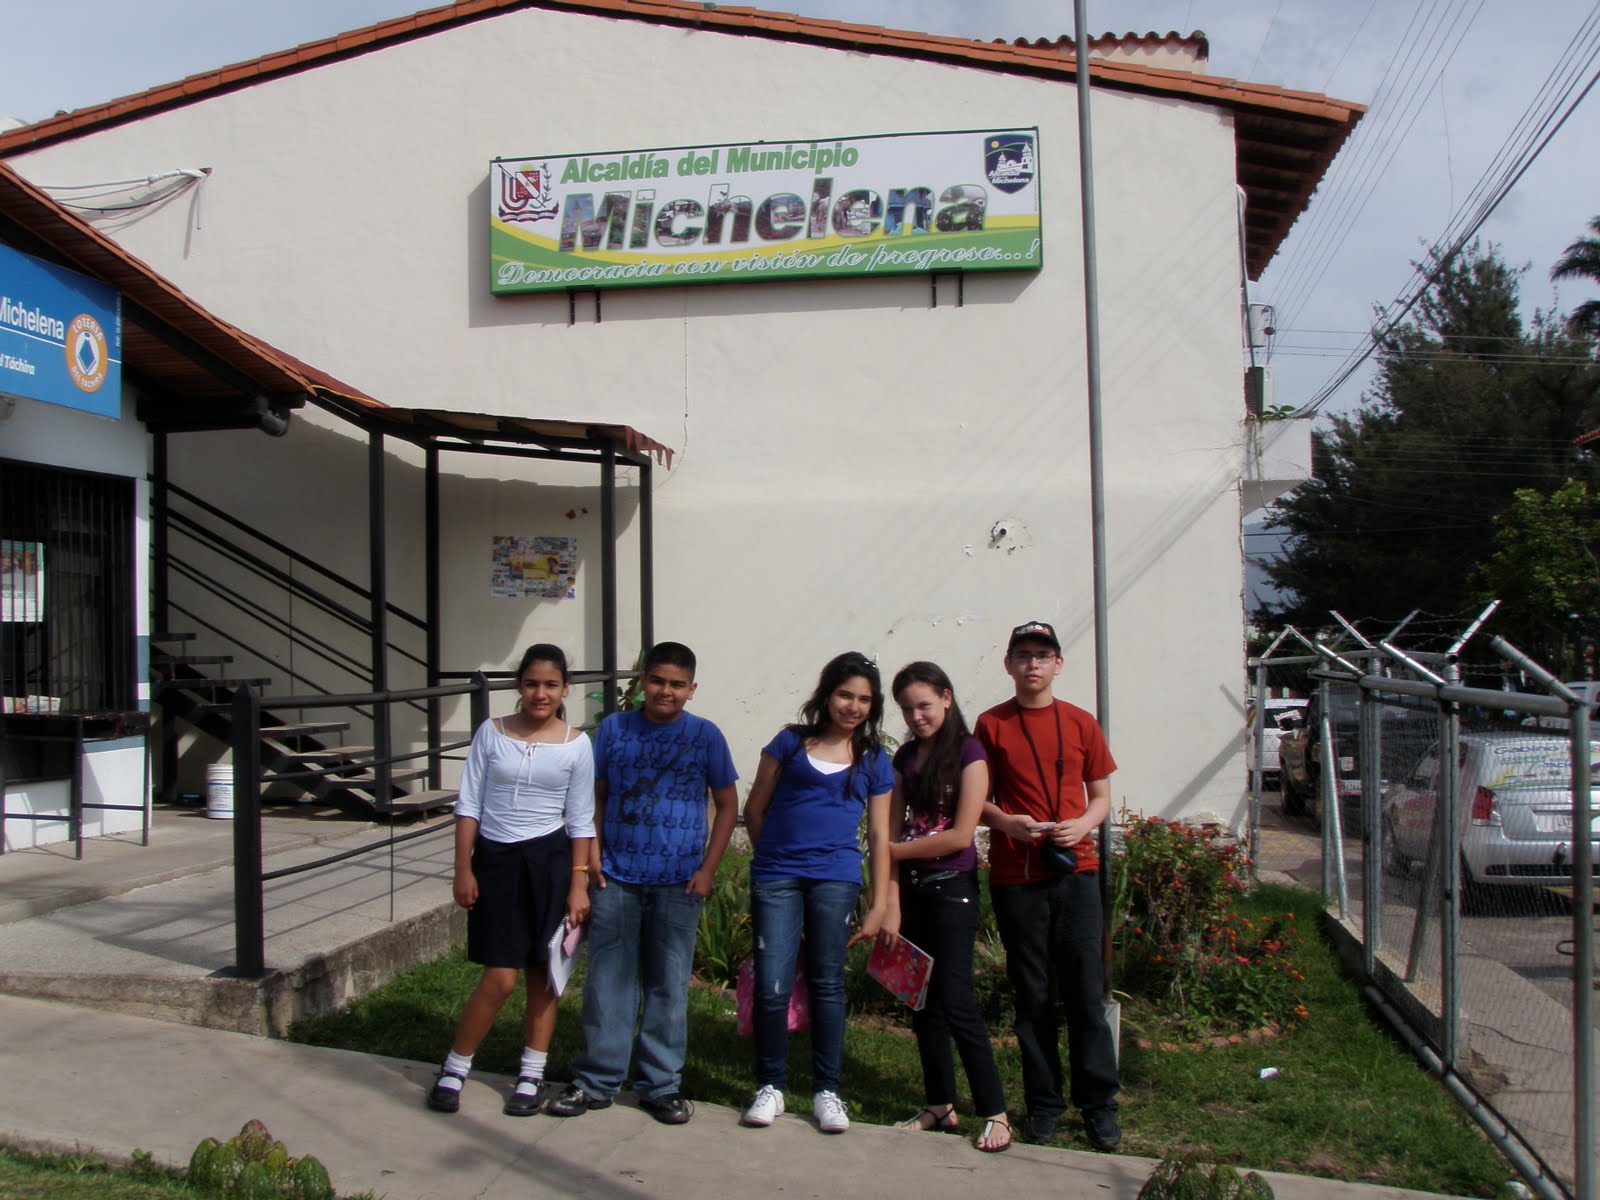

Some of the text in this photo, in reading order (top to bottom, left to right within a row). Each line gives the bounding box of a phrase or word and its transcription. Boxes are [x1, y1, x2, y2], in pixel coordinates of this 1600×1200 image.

[560, 142, 859, 184] Alcaldía del Municipio
[558, 177, 988, 252] Michelena
[497, 258, 672, 285] Democracia
[673, 259, 726, 275] con
[731, 249, 825, 272] visión
[826, 244, 868, 267] de
